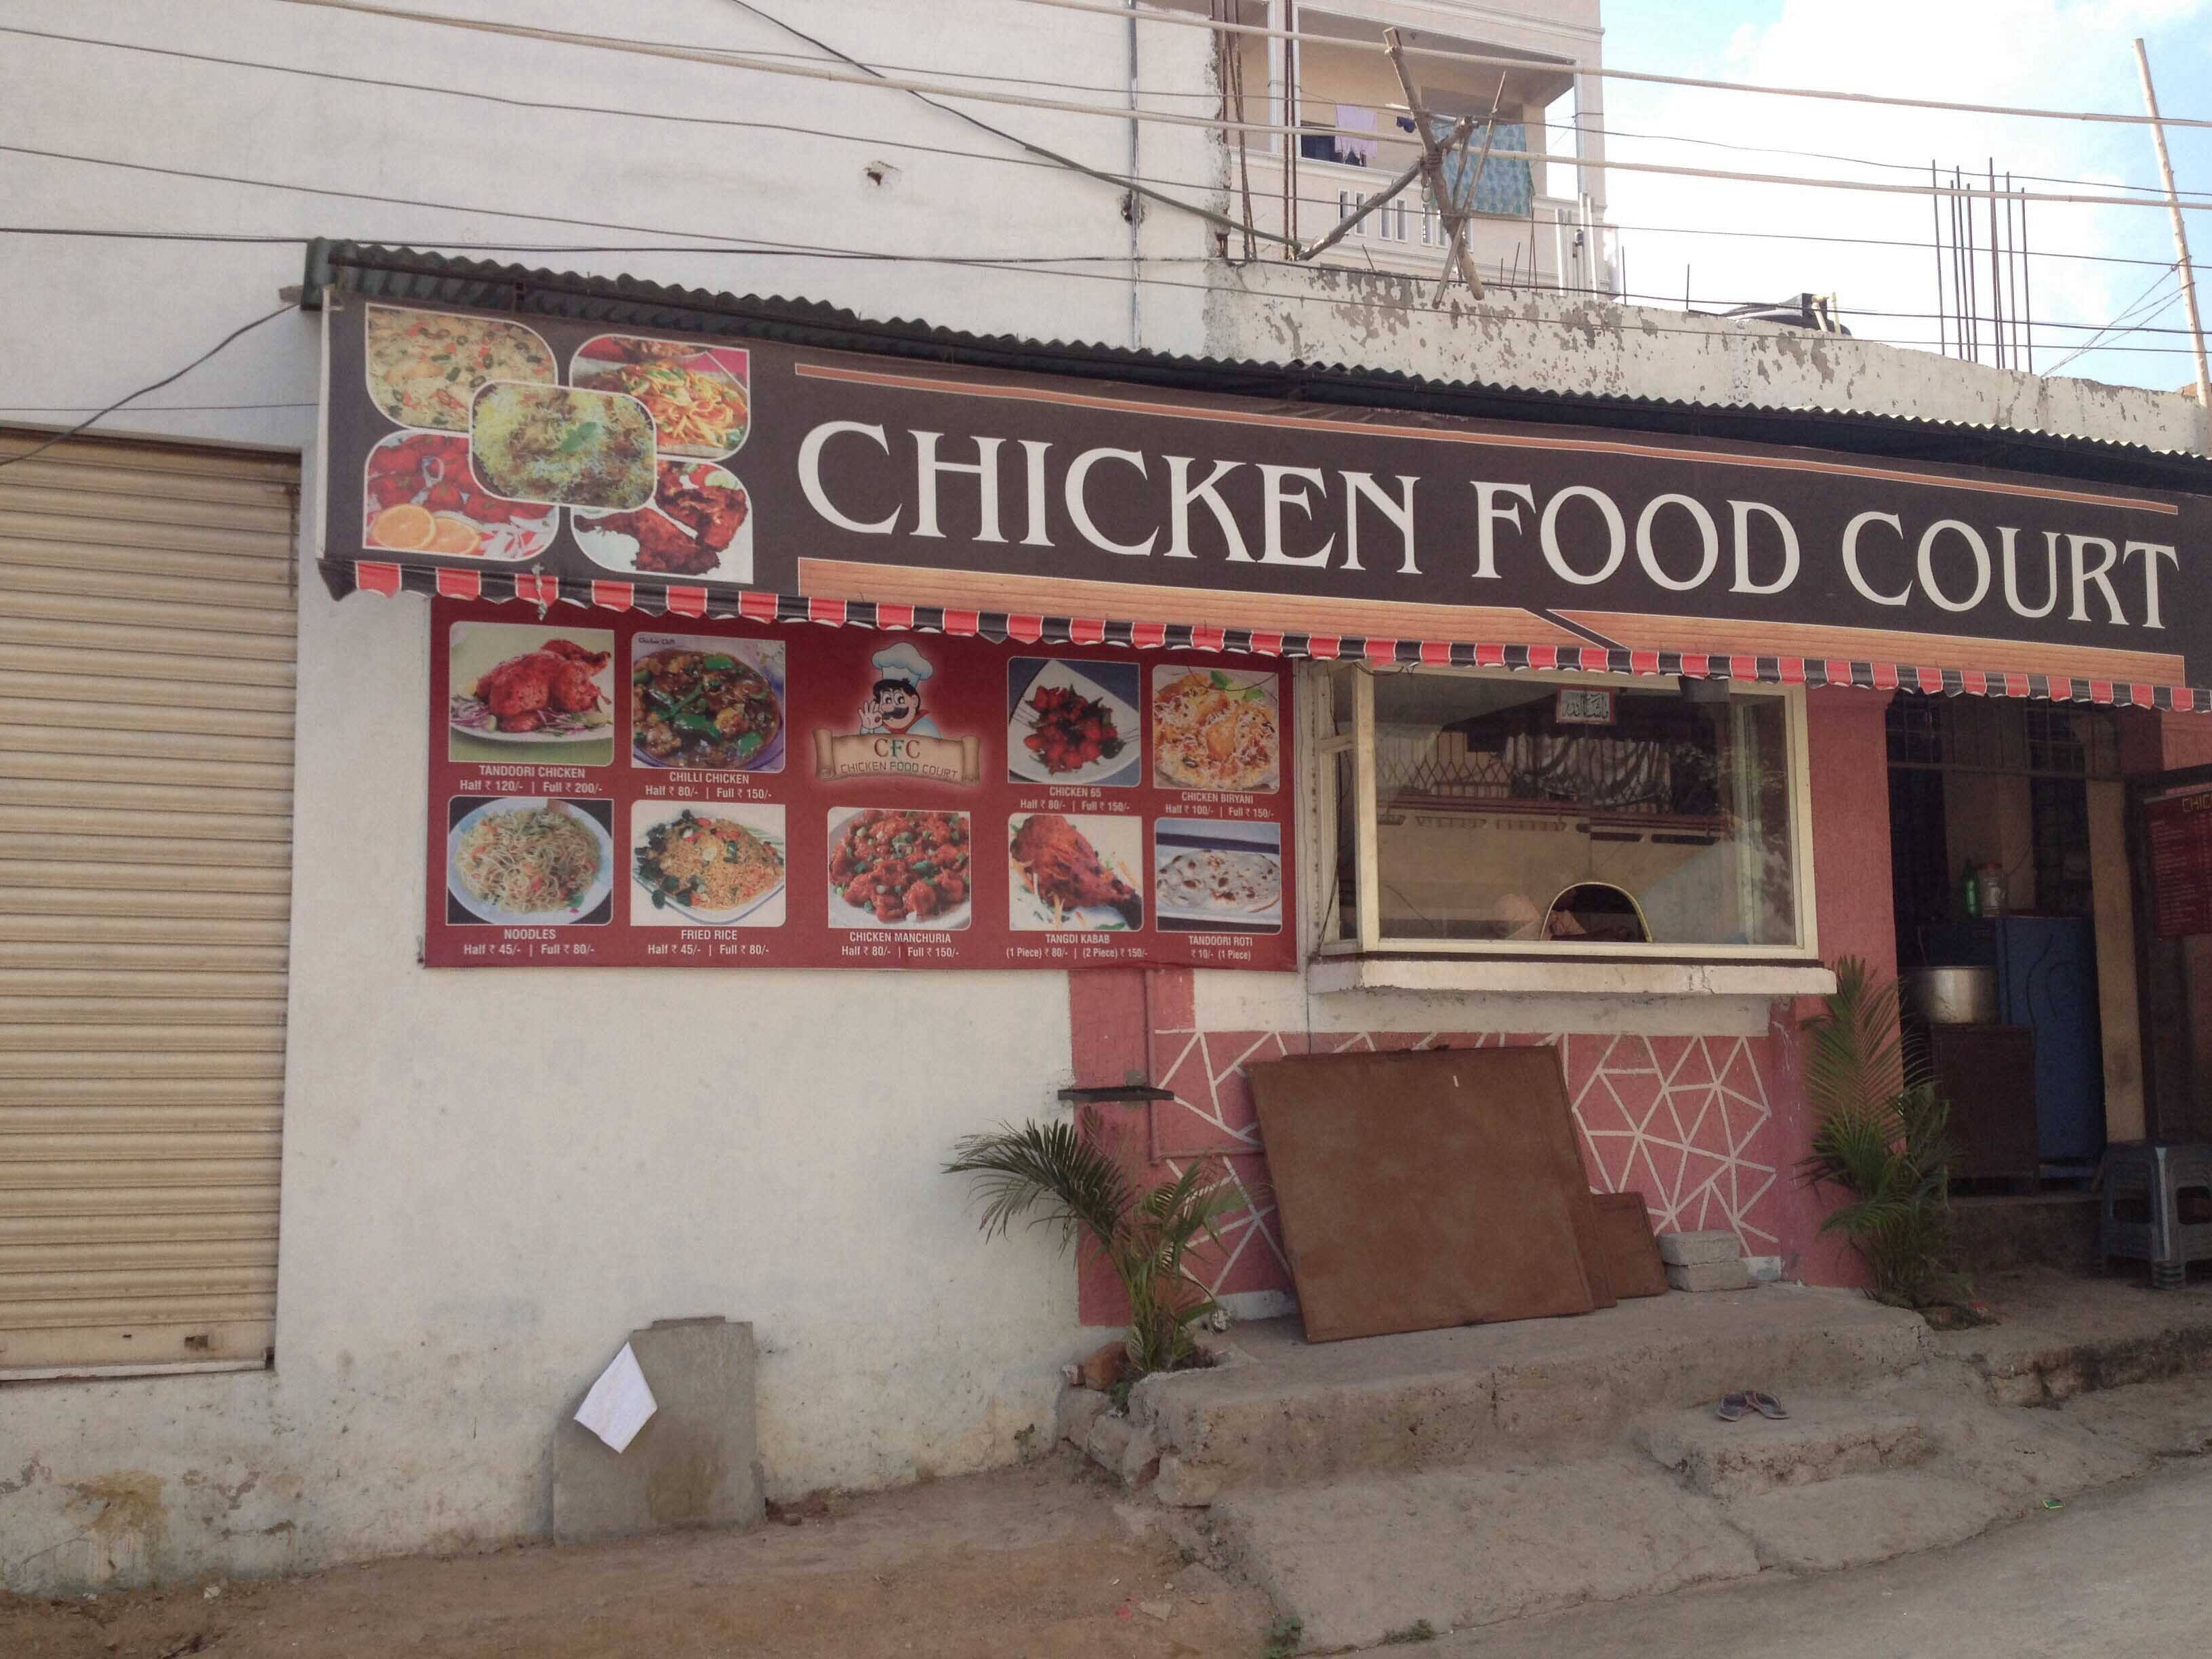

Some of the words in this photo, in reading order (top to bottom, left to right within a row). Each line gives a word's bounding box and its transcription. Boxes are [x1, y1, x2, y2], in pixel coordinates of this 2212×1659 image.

[798, 420, 1422, 575] CHICKEN
[1470, 480, 1800, 595] FOOD
[1842, 511, 2179, 629] COURT
[874, 738, 920, 758] CFC
[479, 765, 535, 777] TANDOORI
[538, 767, 586, 778] CHICKEN
[840, 762, 886, 774] CHICKEN
[890, 762, 919, 771] FOOD
[922, 764, 958, 779] COURT
[670, 772, 702, 782] CHILLI
[705, 773, 750, 784] CHICKEN
[459, 780, 482, 790] Half
[496, 781, 523, 792] 120/-
[544, 781, 562, 792] Full
[575, 783, 602, 794] 200/-
[646, 785, 665, 796] Half
[678, 787, 699, 796] 80/-
[717, 788, 734, 797] Full
[747, 790, 772, 799] 150/-
[1050, 786, 1088, 797] CHICKEN
[1090, 788, 1101, 797] 65
[1182, 792, 1218, 802] CHICKEN
[1221, 794, 1253, 804] BIRYANI
[1021, 800, 1038, 808] Half
[1048, 800, 1065, 809] 80/-
[1082, 801, 1097, 811] Full
[1107, 802, 1130, 812] 150/-
[1166, 804, 1182, 813] Half
[1193, 806, 1214, 815] 100/-
[1229, 807, 1243, 816] Full
[1254, 809, 1274, 818] 150/-
[504, 929, 556, 939] NOODLES
[681, 930, 711, 939] FRIED
[715, 930, 737, 940] RICE
[850, 932, 891, 942] CHICKEN
[895, 933, 951, 943] MANCHURIA
[1046, 934, 1078, 943] TANGDI
[1081, 935, 1110, 943] KABAB
[1189, 935, 1231, 946] TANDOORI
[1233, 937, 1252, 946] ROTI
[464, 944, 486, 954] Half
[499, 944, 520, 955] 45/-
[541, 944, 560, 954] Full
[573, 944, 594, 955] 80/-
[648, 944, 668, 954] Half
[680, 945, 701, 955] 45/-
[720, 944, 737, 954] Full
[750, 945, 769, 955] 80/-
[842, 946, 861, 956] Half
[872, 946, 890, 956] 80/-
[908, 947, 924, 957] Full
[936, 948, 959, 958] 150/-
[1006, 947, 1014, 959] (1
[1017, 947, 1042, 959] Piece)
[1052, 949, 1067, 958] 80/-
[1083, 947, 1091, 959] (2
[1093, 948, 1118, 960] Piece)
[1128, 949, 1147, 959] 150/-
[1198, 949, 1213, 959] 10/-
[1218, 949, 1225, 960] (1
[1228, 950, 1251, 961] Piece)
